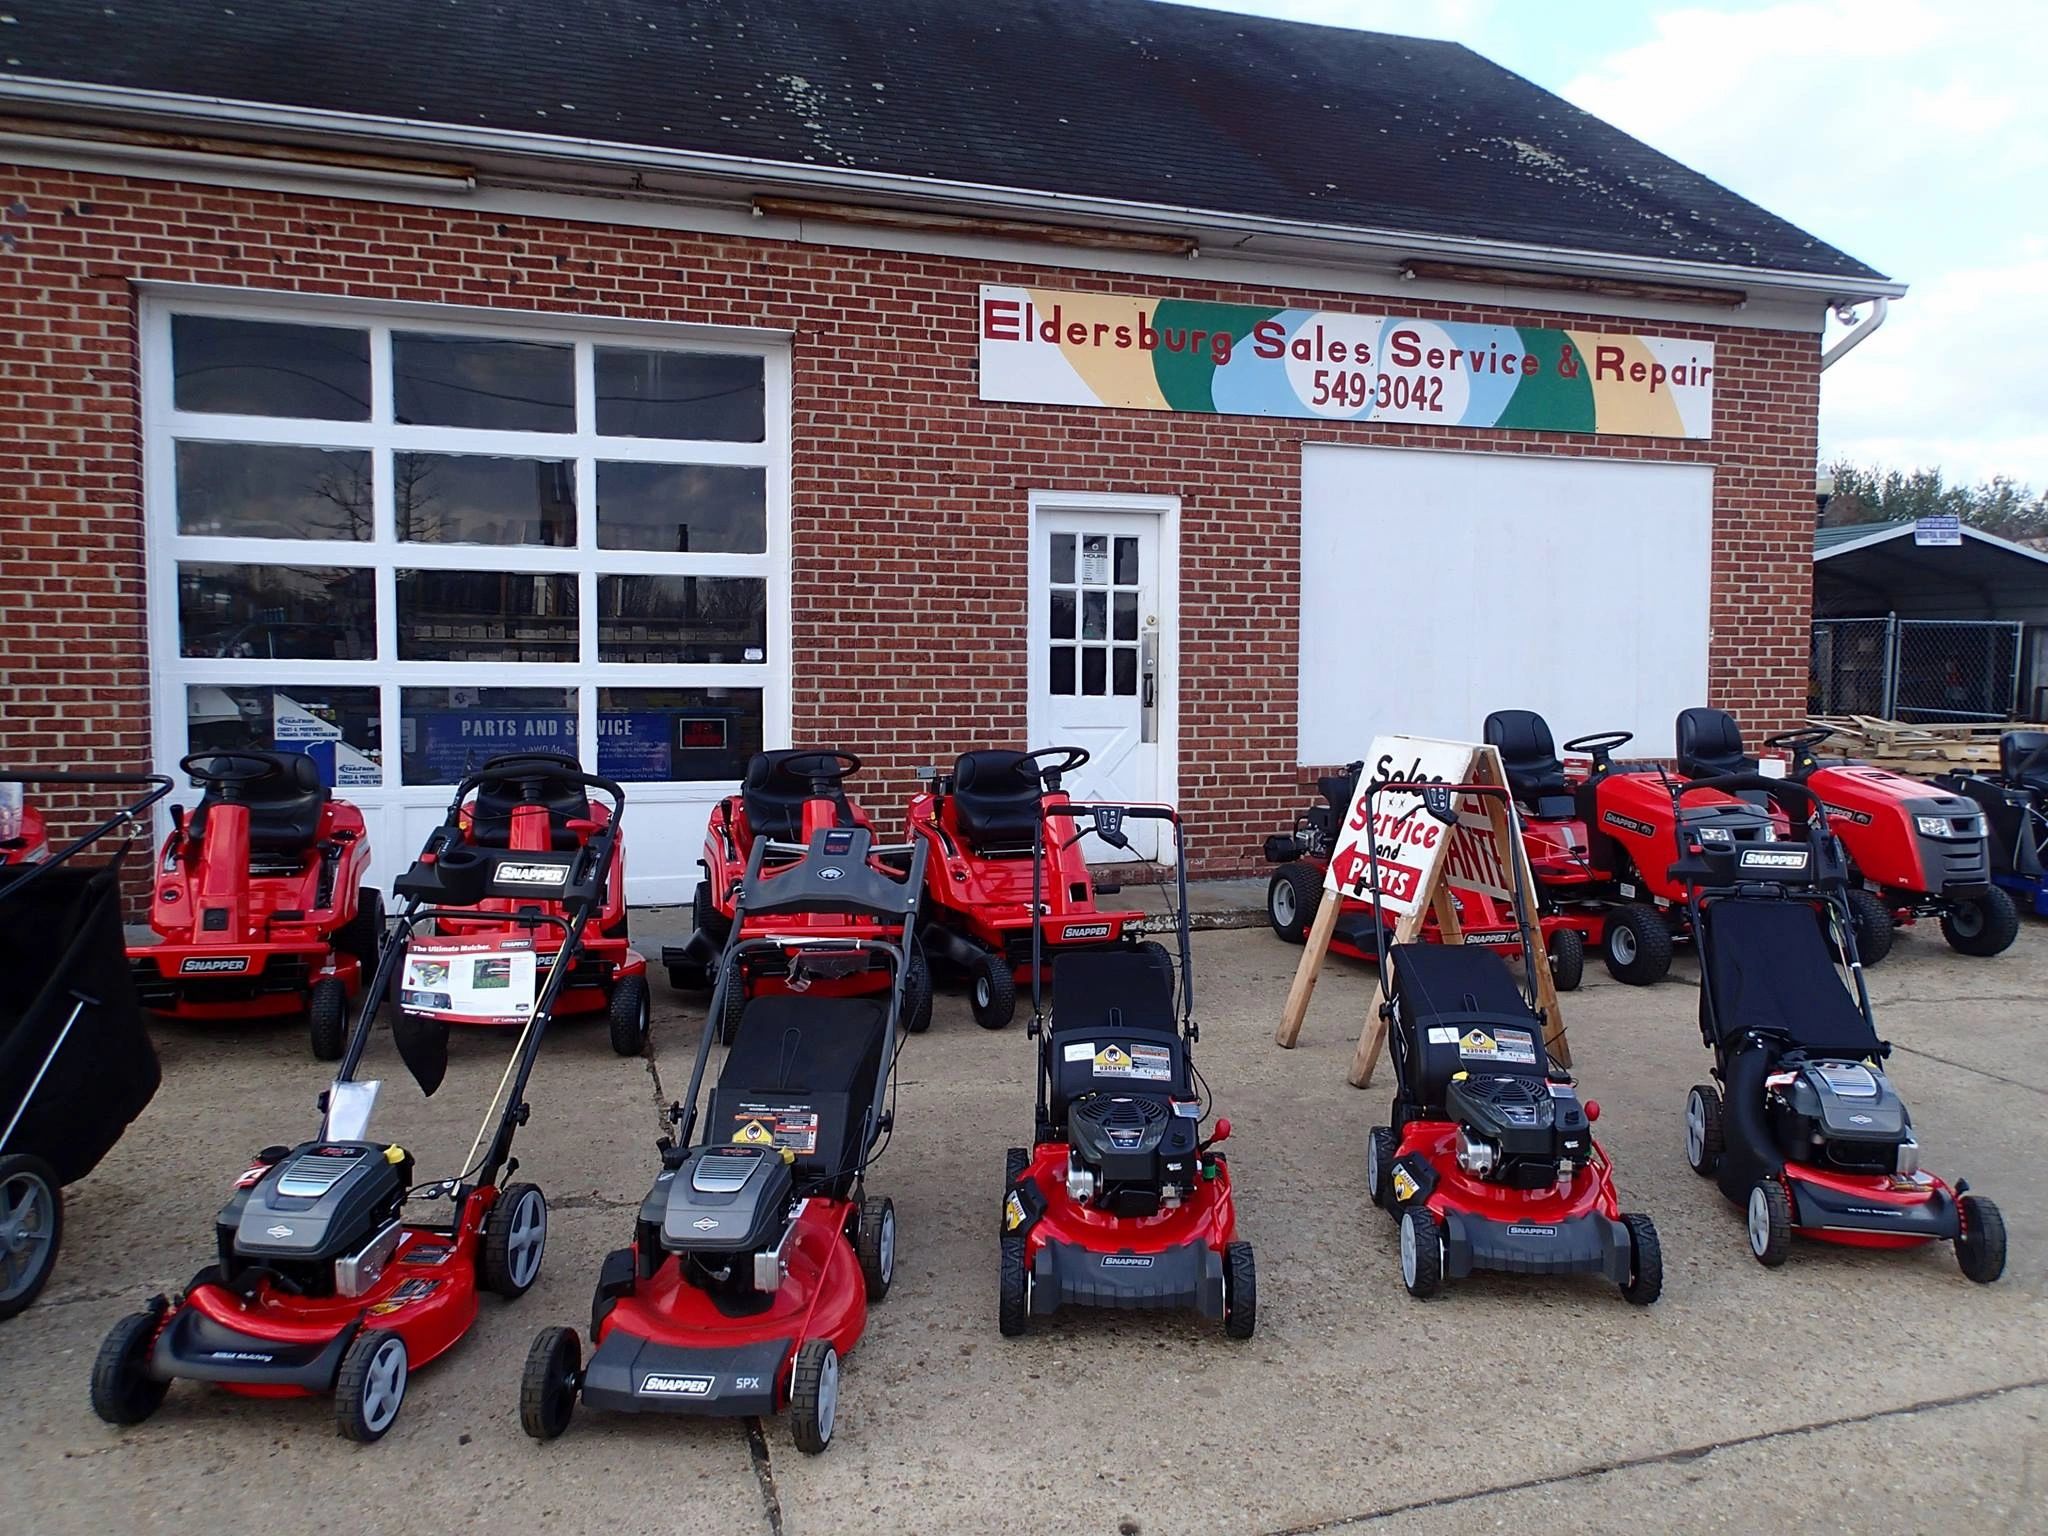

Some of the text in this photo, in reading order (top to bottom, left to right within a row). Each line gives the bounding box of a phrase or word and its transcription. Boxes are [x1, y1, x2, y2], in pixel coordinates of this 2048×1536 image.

[984, 299, 1713, 394] Eldersburg Sales Service & Repair
[461, 719, 633, 737] PARTS AND SVICE
[1349, 796, 1439, 849] Service
[1375, 843, 1402, 861] and
[1745, 853, 1802, 866] SNAPPER
[500, 866, 564, 882] SNAPPER
[1348, 857, 1410, 896] PARTS
[1065, 927, 1107, 937] SNAPPER
[1466, 934, 1506, 944] SNAPPER
[184, 960, 244, 971] SNAPPER
[1510, 1227, 1554, 1236] SNAPPER
[1105, 1257, 1151, 1266] SNAPPER
[645, 1376, 759, 1392] SNAPPER SPX
